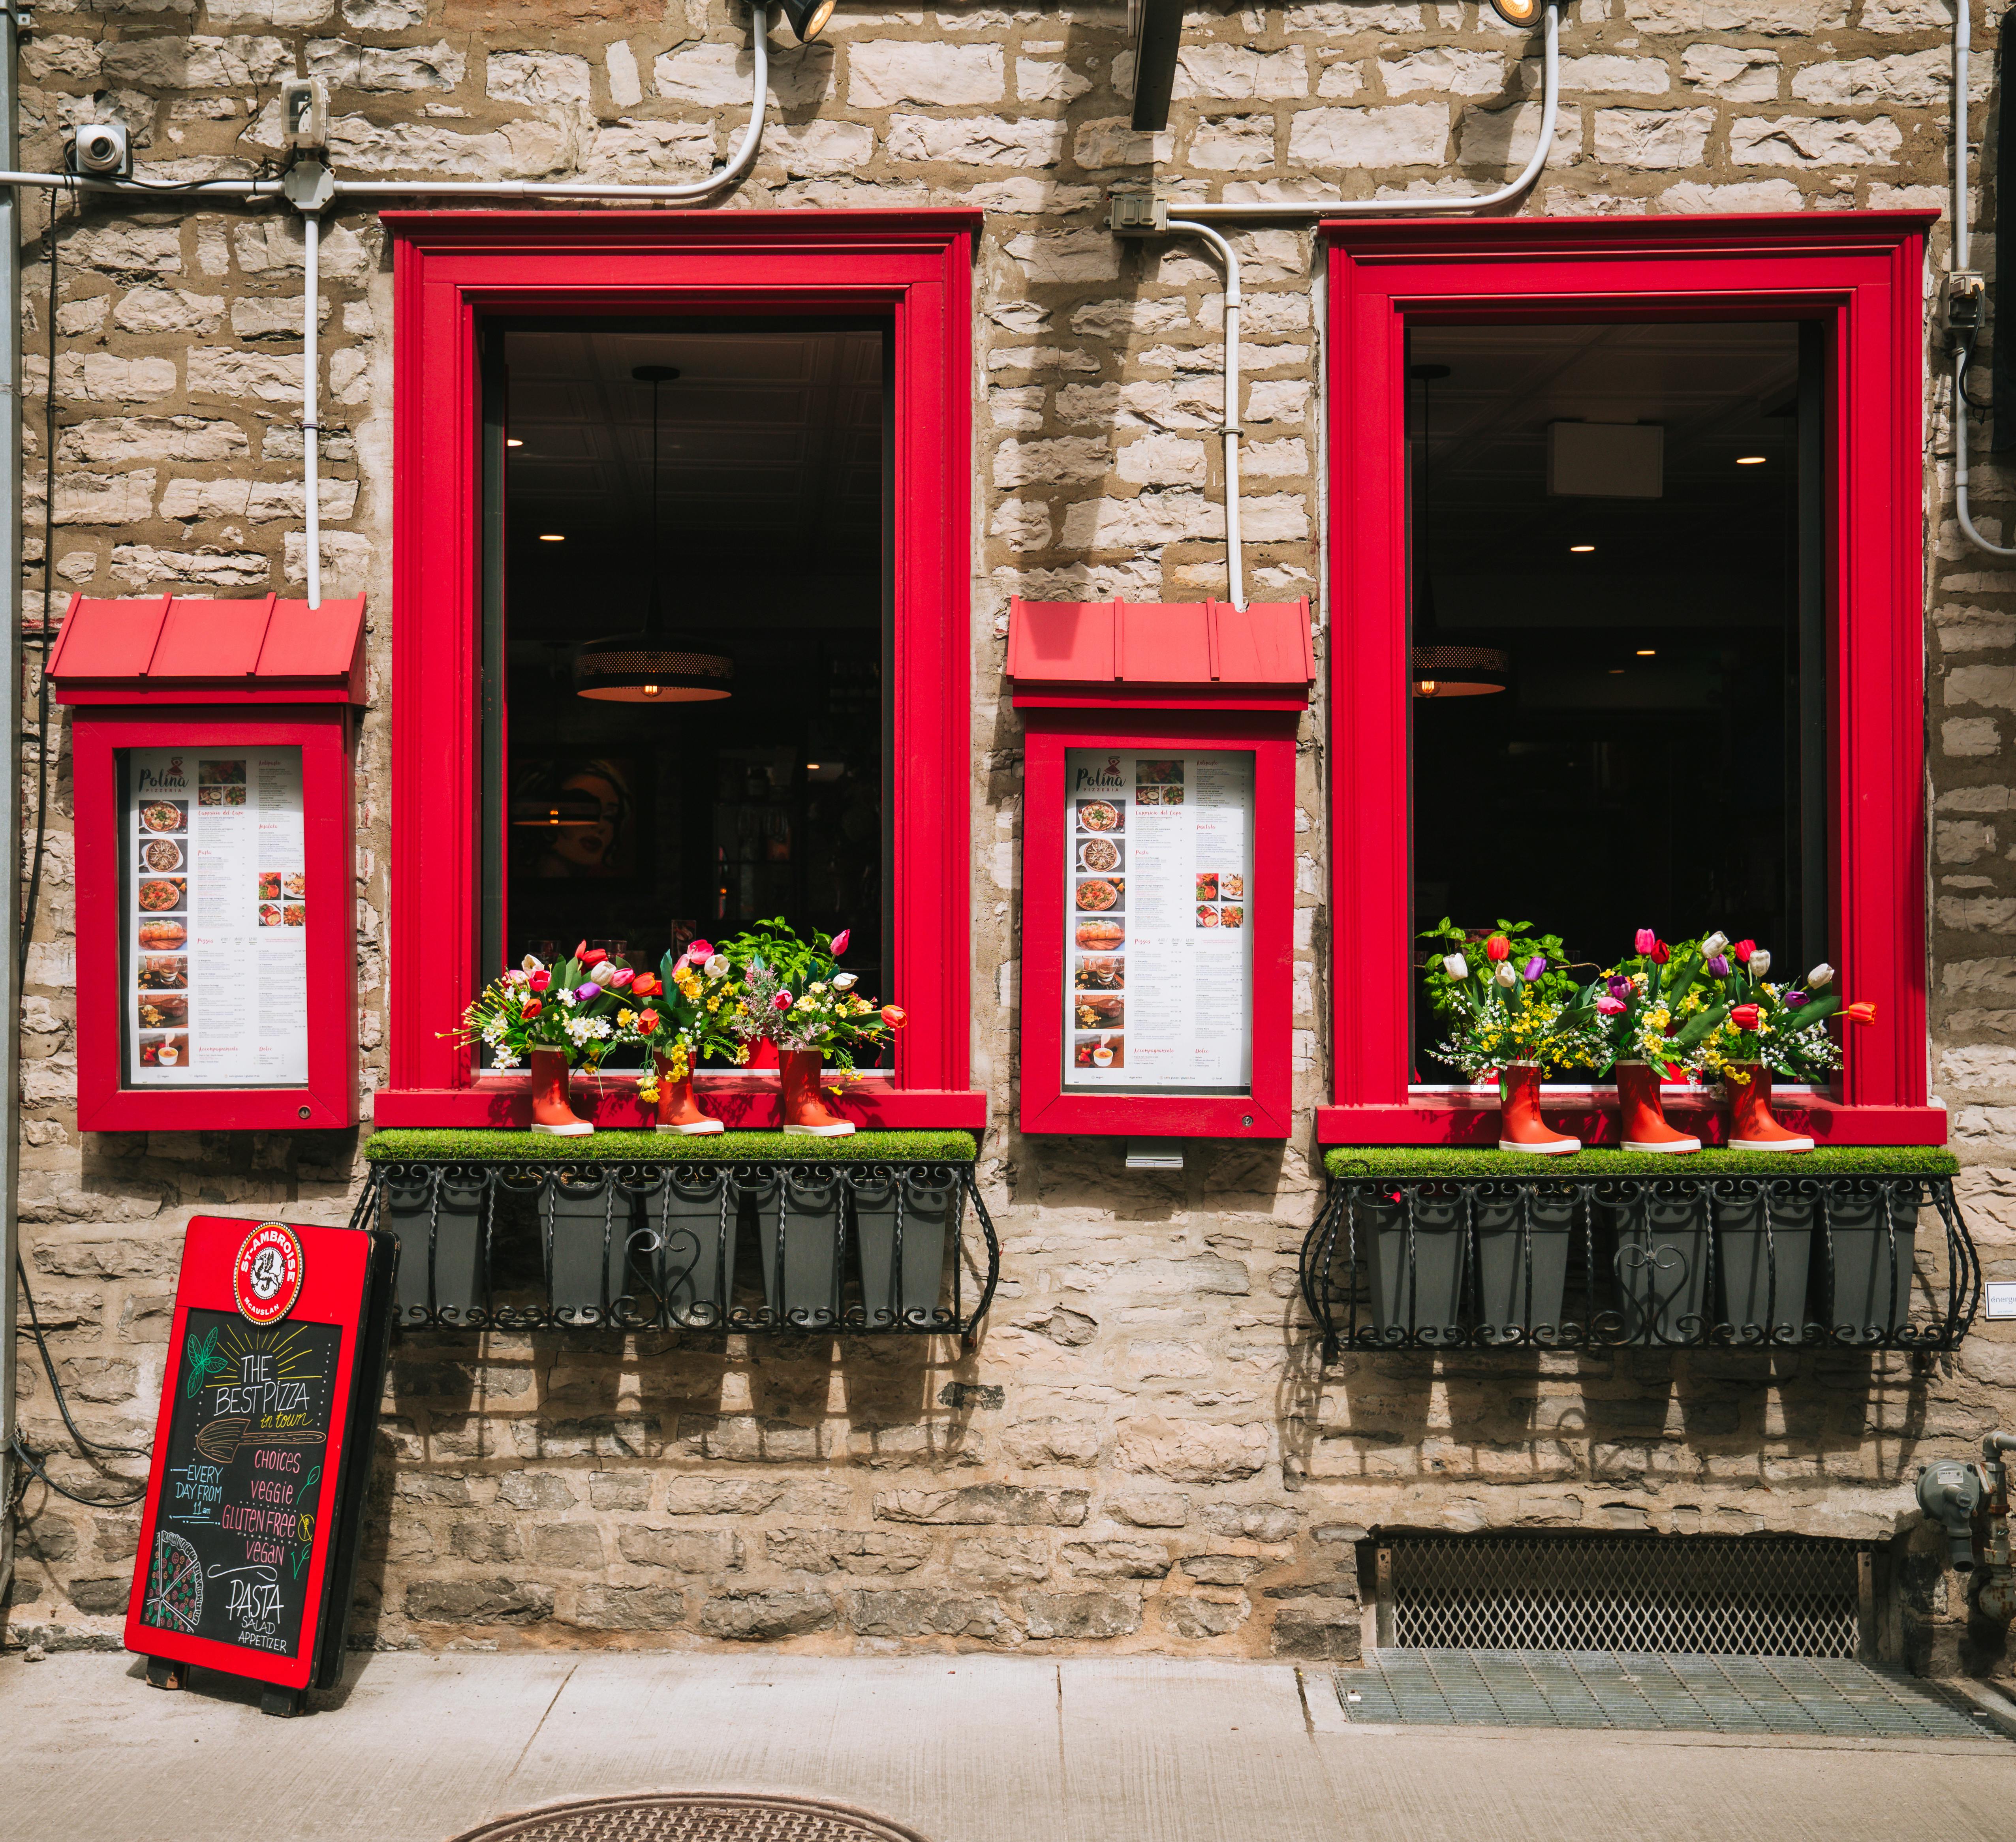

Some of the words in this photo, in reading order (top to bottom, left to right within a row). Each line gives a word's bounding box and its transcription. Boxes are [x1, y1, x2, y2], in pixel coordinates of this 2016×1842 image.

[139, 769, 190, 792] Polina
[1076, 768, 1126, 792] Polina
[240, 1230, 296, 1282] ST-AMBROISE
[244, 1296, 280, 1316] MCAUSLAN
[241, 1355, 272, 1382] THE
[214, 1386, 263, 1416] BEST
[261, 1413, 273, 1428] in
[276, 1412, 313, 1428] town
[187, 1465, 224, 1484] EVERY
[175, 1481, 197, 1499] DAY
[197, 1486, 222, 1504] FROM
[193, 1501, 201, 1515] 11
[225, 1579, 284, 1624] PASTA
[241, 1616, 276, 1635] SALAD
